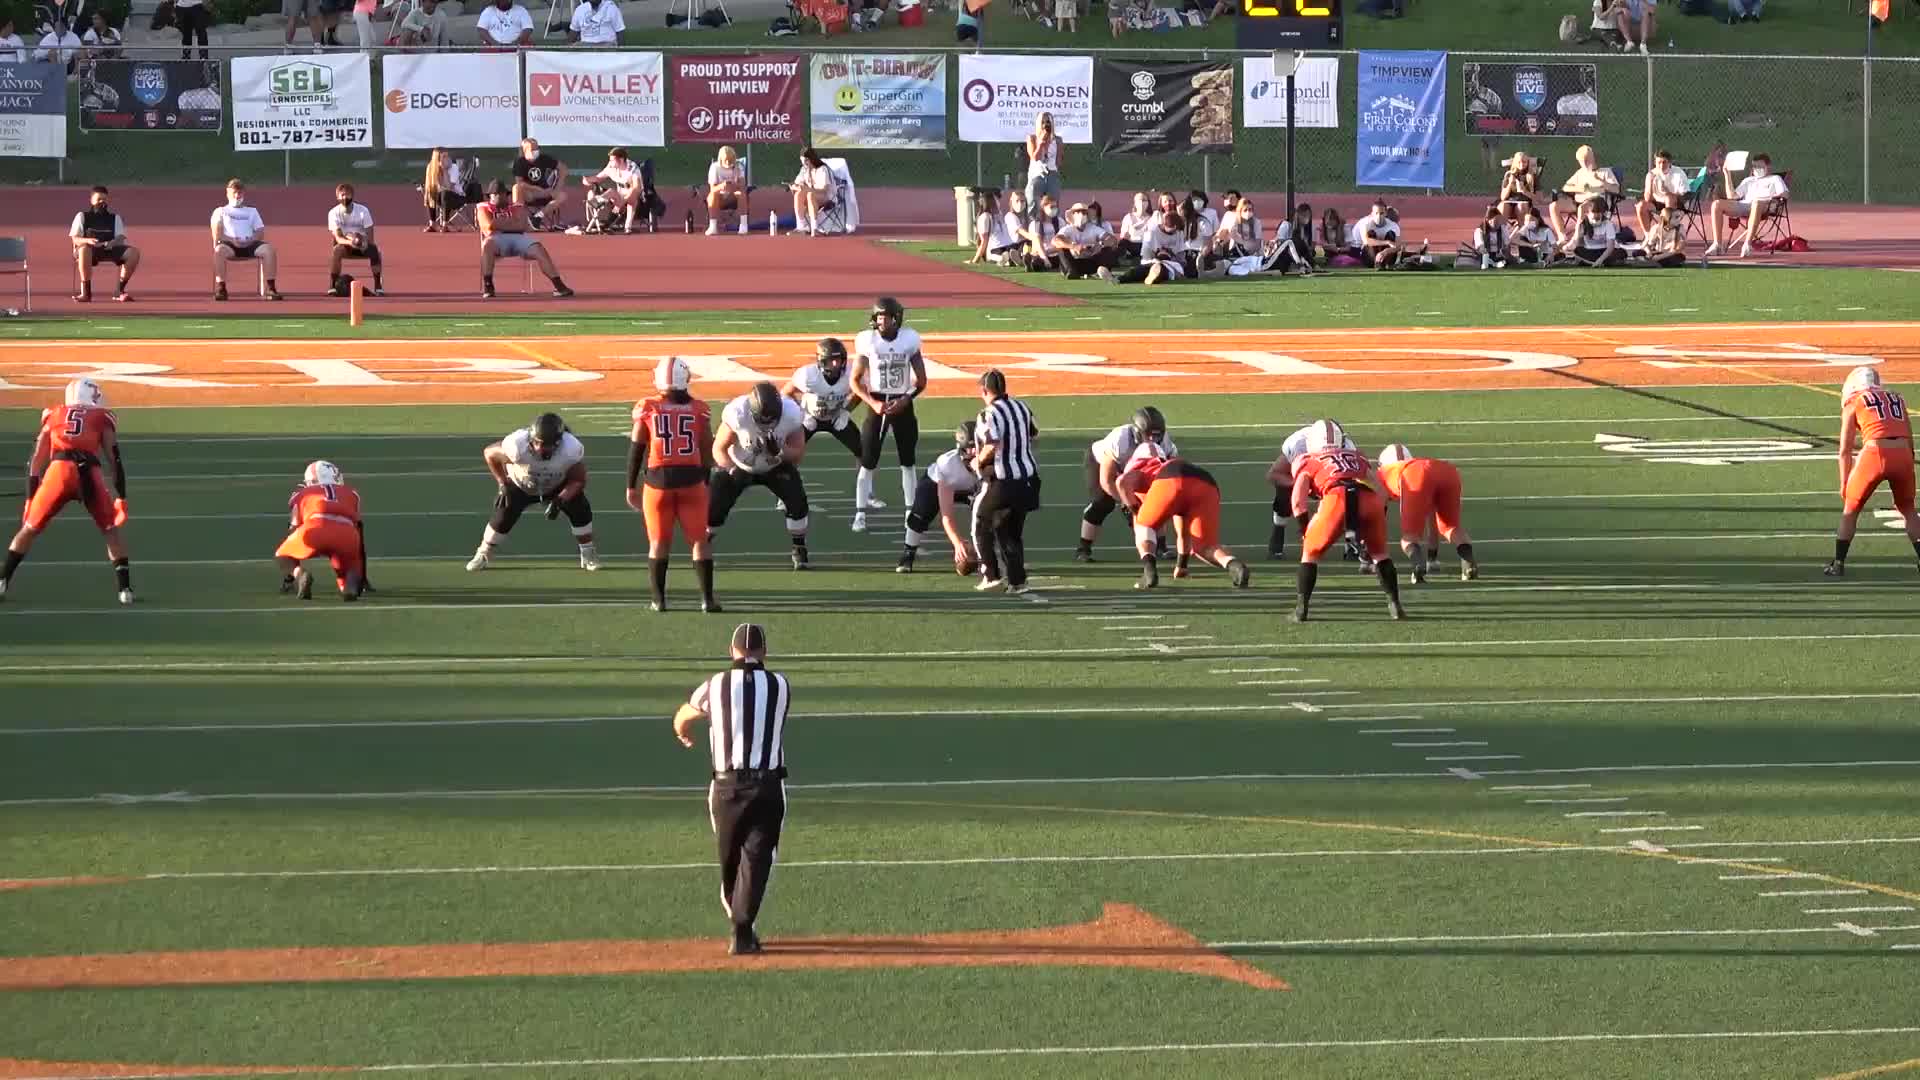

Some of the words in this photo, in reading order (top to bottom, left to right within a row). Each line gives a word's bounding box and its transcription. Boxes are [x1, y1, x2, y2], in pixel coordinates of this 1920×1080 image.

[681, 64, 722, 77] PROUD
[725, 64, 740, 76] TO
[743, 63, 798, 77] SUPPORT
[1371, 66, 1434, 78] TIMPVIEW
[135, 80, 165, 89] LIVE
[273, 68, 329, 93] S&L
[562, 74, 659, 94] VALLEY
[708, 81, 770, 94] TIMPVIEW
[997, 85, 1089, 98] FRANDSEN
[1270, 81, 1330, 104] Trpnell
[1516, 85, 1545, 94] LIVE
[273, 94, 330, 103] LANDSCAPES
[411, 92, 519, 109] EDGEhomes
[564, 96, 616, 105] WOMEN'S
[618, 96, 659, 106] HEALTH
[863, 90, 923, 105] SuperGrin
[997, 101, 1088, 109] ORTHODONTICS
[1121, 101, 1165, 113] crumbl
[294, 108, 311, 116] LLC
[531, 112, 659, 125] valleywomenshealth.com
[237, 119, 298, 129] RESIDENTIAL
[309, 117, 369, 127] COMMERCIAL
[717, 109, 754, 130] jiffy
[755, 109, 790, 125] lube
[1364, 112, 1393, 126] FIRST
[240, 129, 367, 144] 801-787-3457
[735, 128, 792, 140] multicare
[1370, 145, 1391, 156] YOUR
[1391, 146, 1408, 157] WAY
[1861, 391, 1904, 420] 48
[64, 408, 88, 437] 5
[652, 413, 696, 456] 45
